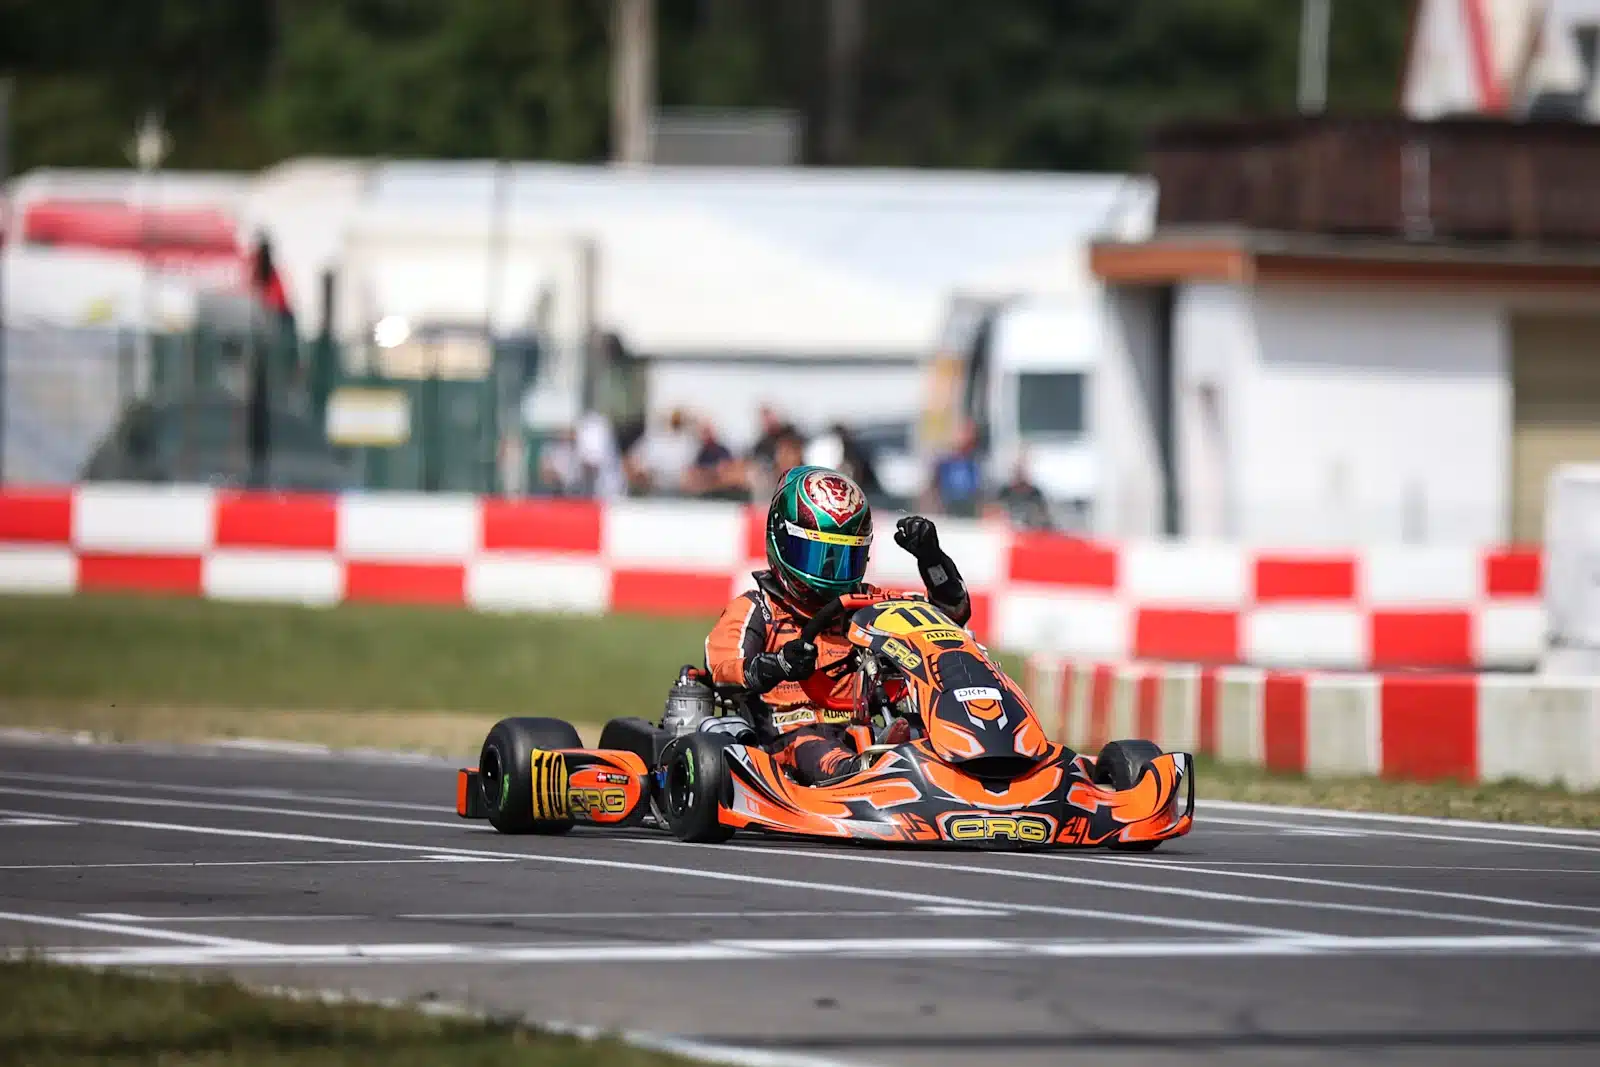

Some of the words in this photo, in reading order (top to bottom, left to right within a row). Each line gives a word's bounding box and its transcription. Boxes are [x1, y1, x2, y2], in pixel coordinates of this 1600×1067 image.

[926, 631, 963, 640] ADAC
[880, 637, 922, 670] CRG
[958, 689, 987, 697] DKM
[534, 751, 562, 817] 110
[567, 787, 626, 815] CRG
[951, 818, 1047, 841] CRG
